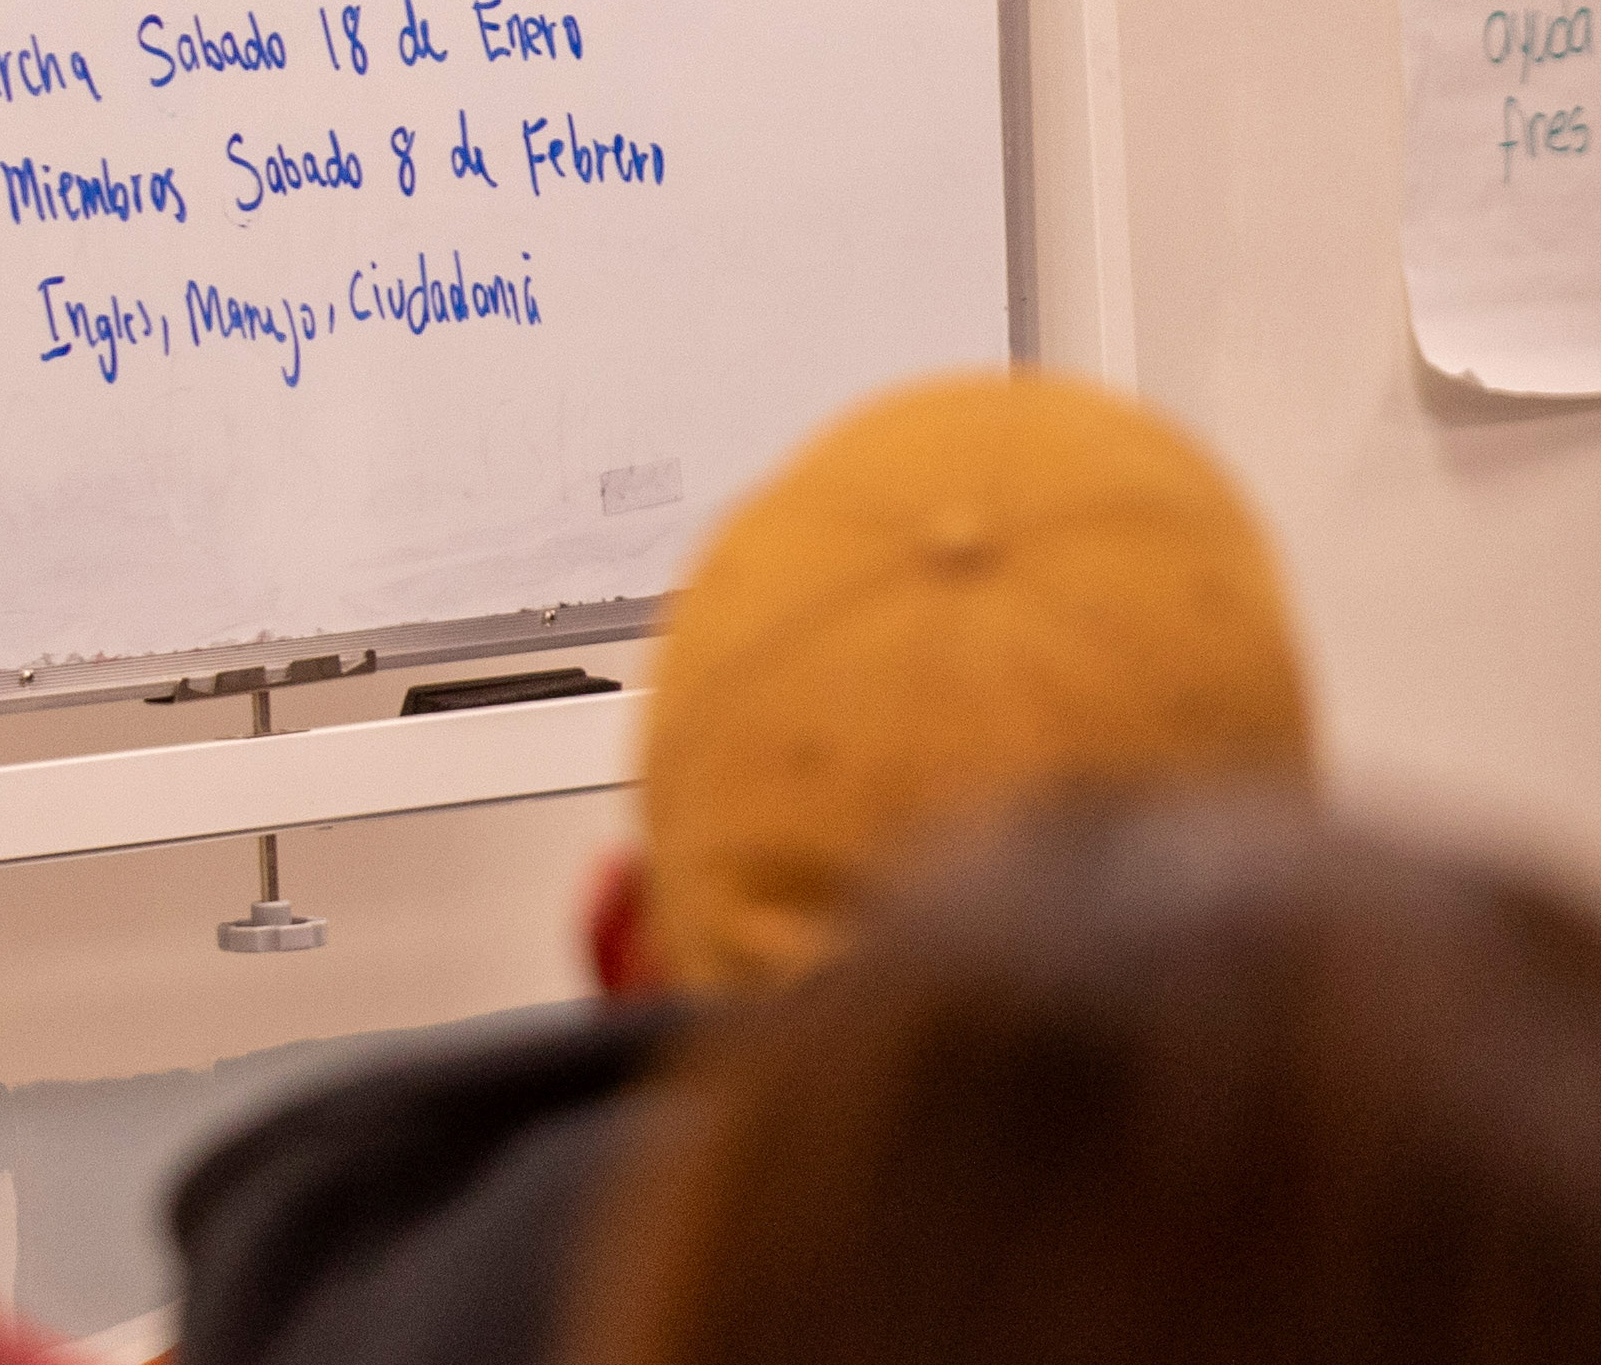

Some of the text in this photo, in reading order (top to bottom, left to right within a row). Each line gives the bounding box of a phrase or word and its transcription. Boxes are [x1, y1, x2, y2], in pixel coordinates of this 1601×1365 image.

[136, 11, 288, 88] Sabado
[319, 3, 370, 76] 18
[225, 128, 364, 213] Sabado
[390, 124, 418, 198] 8
[521, 112, 667, 197] Febrero
